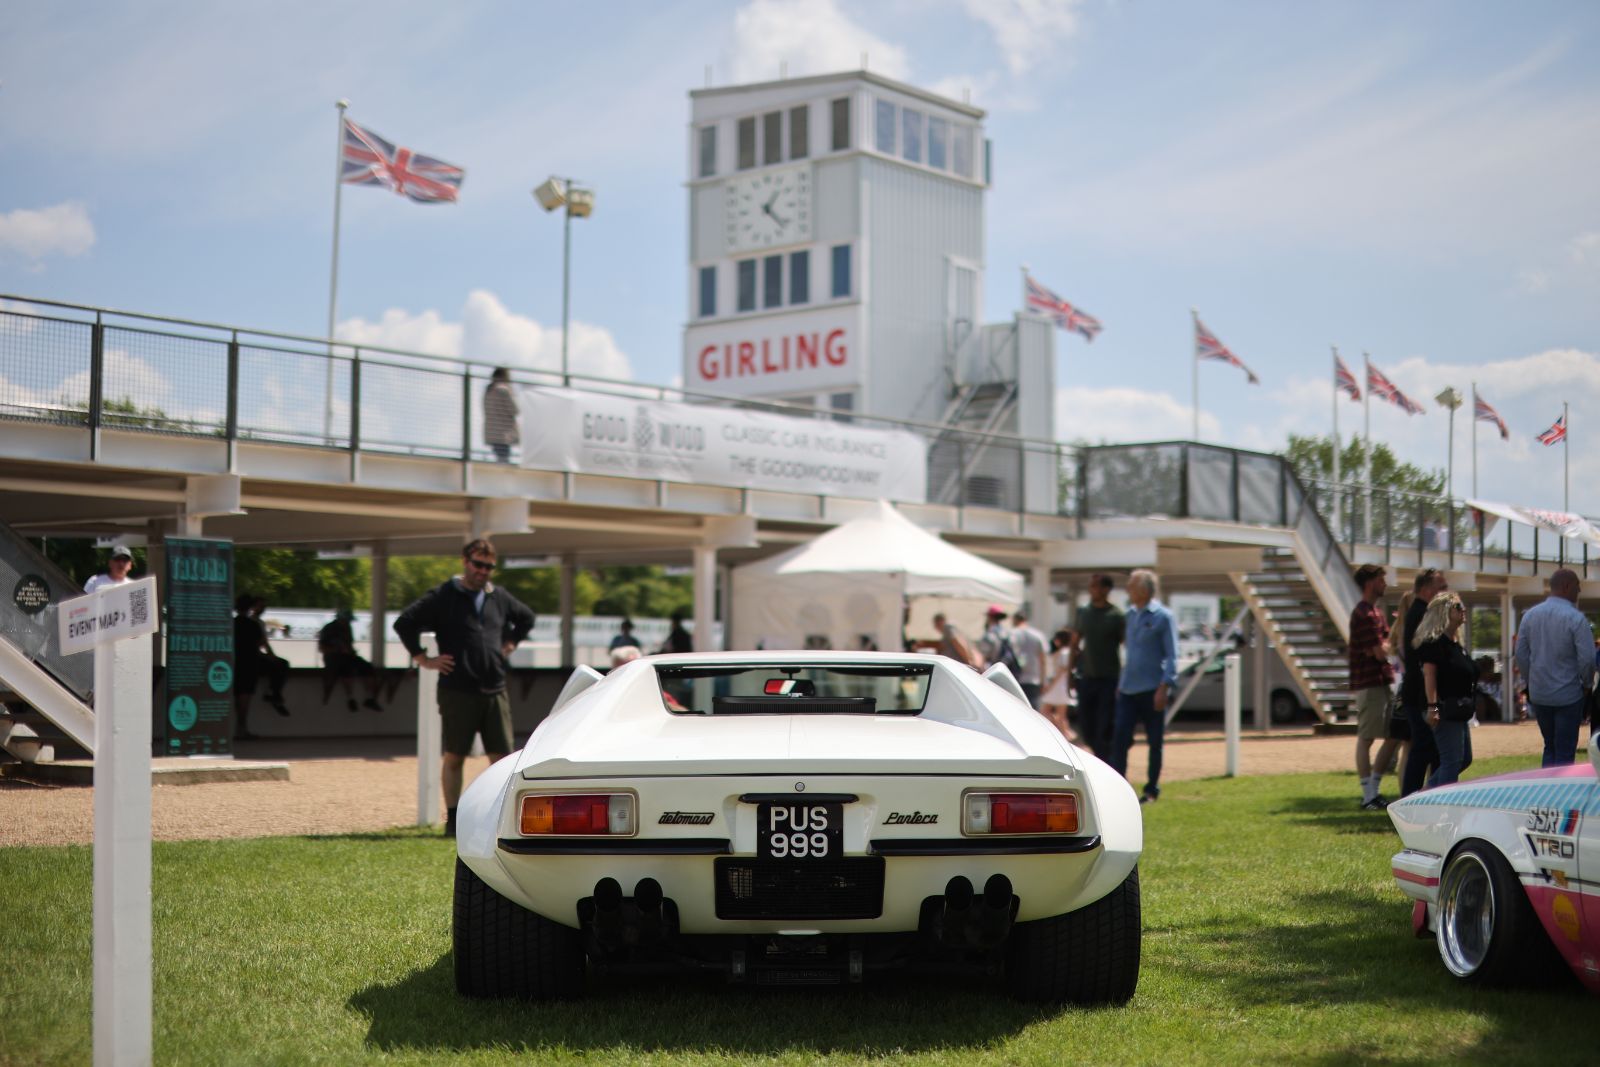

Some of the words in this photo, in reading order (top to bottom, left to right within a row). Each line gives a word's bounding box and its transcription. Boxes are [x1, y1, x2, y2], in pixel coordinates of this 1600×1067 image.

[698, 328, 847, 380] GIRLING
[781, 431, 809, 448] CAR
[729, 454, 756, 475] THE
[760, 458, 850, 484] GOODWOOD
[69, 617, 96, 638] EVENT
[99, 611, 119, 630] MAP
[770, 806, 828, 832] PUS
[882, 811, 939, 825] Pantera
[1528, 805, 1559, 833] SSR
[770, 833, 829, 858] 999
[1537, 838, 1574, 859] TRD
